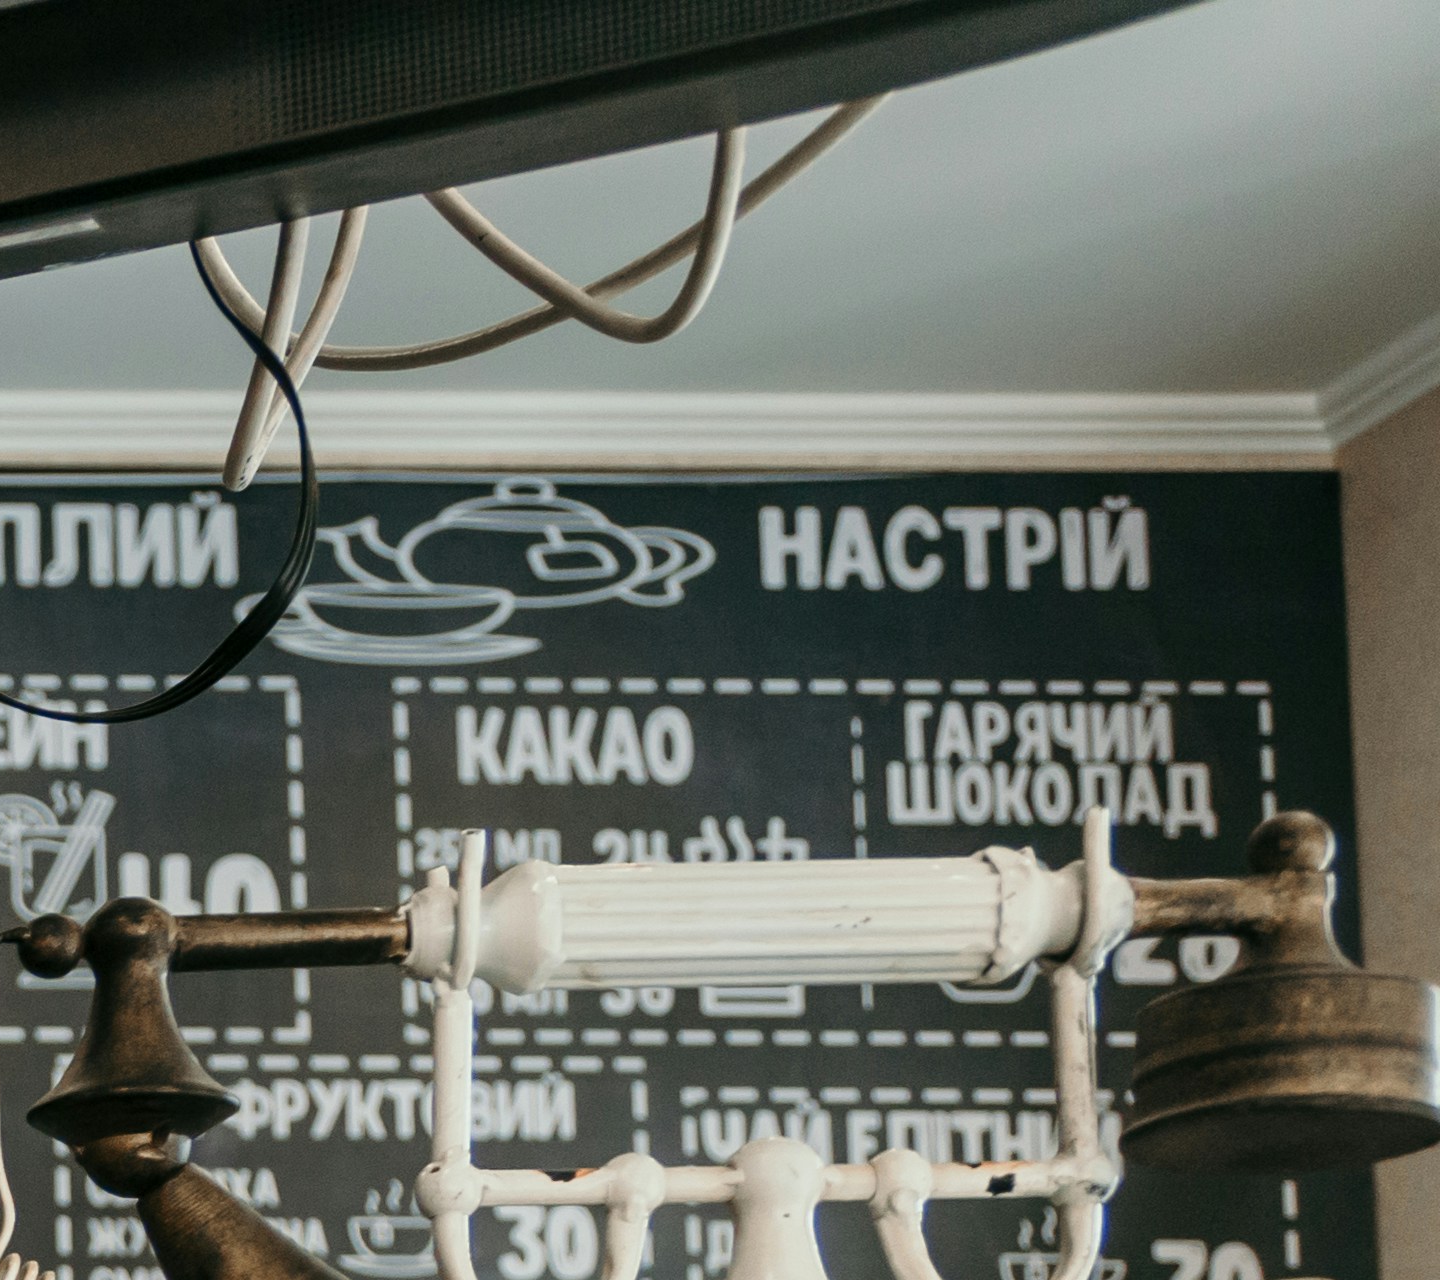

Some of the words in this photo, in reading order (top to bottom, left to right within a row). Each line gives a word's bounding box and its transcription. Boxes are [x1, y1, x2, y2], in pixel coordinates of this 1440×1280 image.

[757, 494, 1152, 592] НАСТРІЙ
[454, 704, 696, 787] КАКАО
[903, 693, 1175, 764] ГАРЯЧИЙ
[886, 759, 1216, 838] ШОКОЛАД
